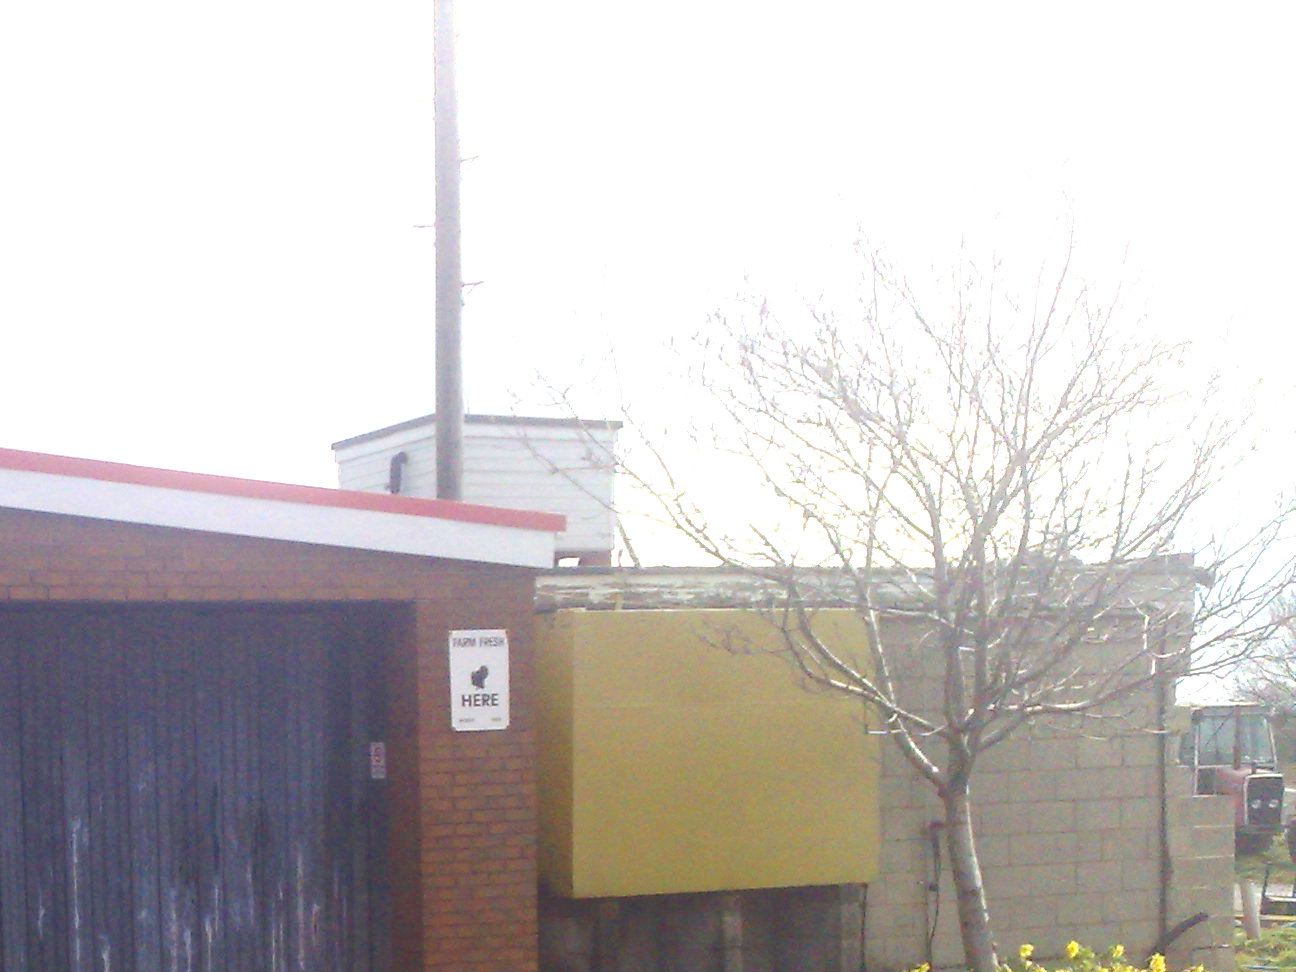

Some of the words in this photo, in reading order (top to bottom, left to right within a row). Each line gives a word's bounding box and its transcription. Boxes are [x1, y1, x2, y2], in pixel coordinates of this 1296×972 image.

[452, 637, 477, 648] FARM
[479, 636, 506, 648] FRESH
[461, 693, 500, 707] HERE
